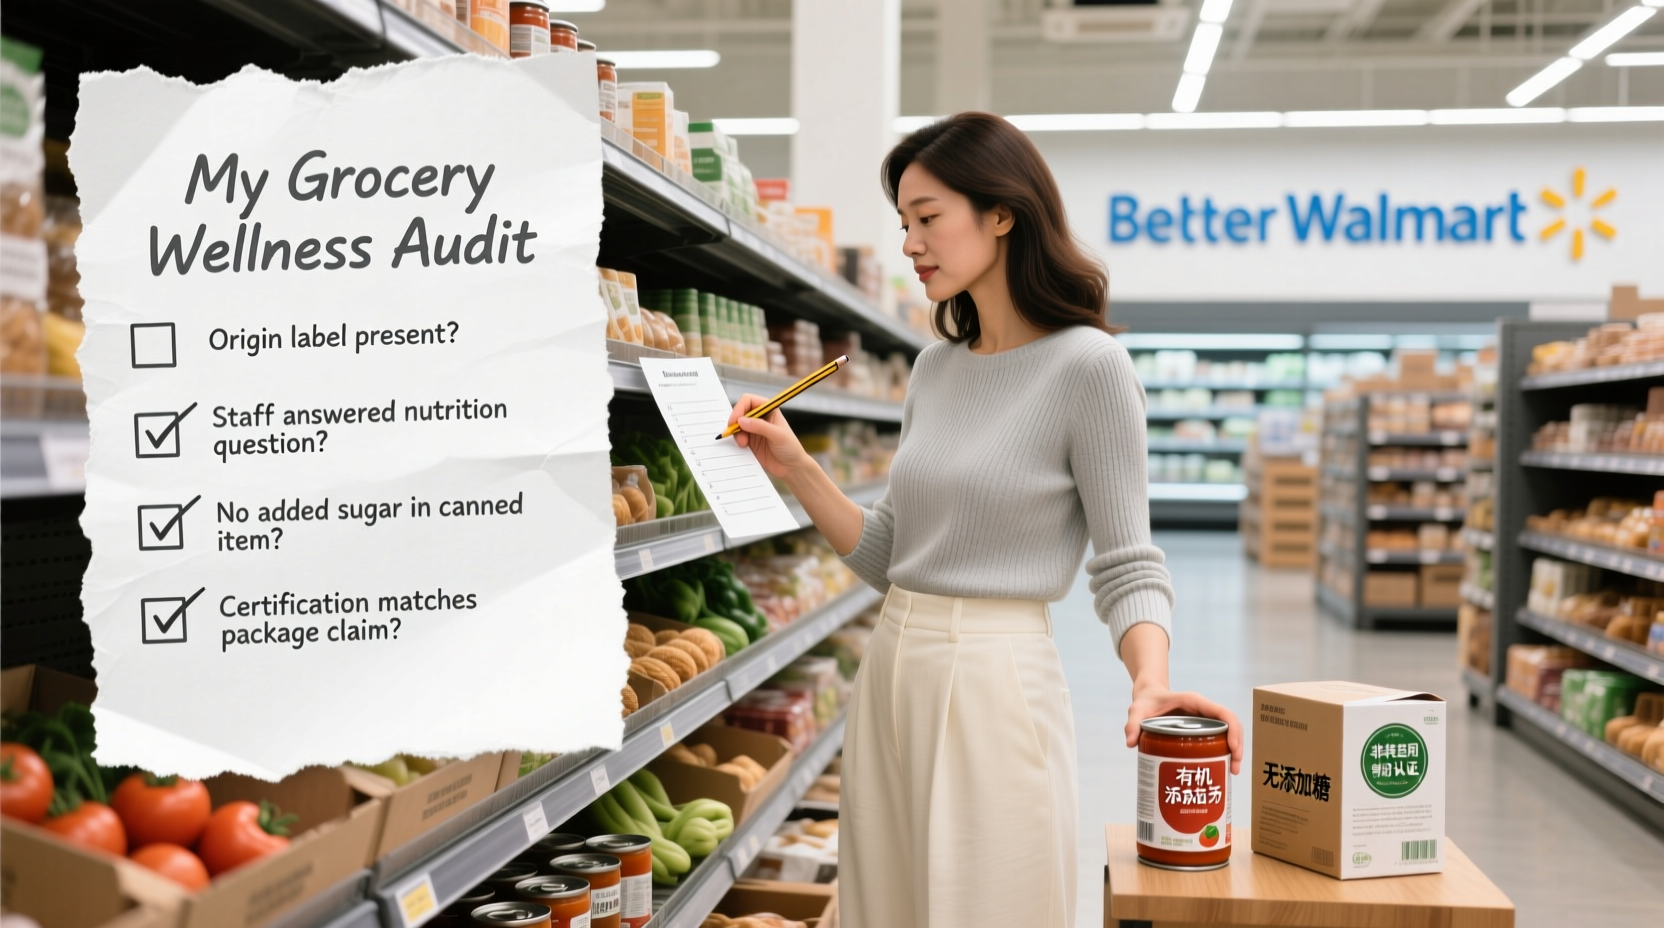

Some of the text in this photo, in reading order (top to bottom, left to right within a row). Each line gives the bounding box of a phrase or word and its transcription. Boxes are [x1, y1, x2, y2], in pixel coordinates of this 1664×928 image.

[185, 150, 495, 219] My Grocery
[1108, 191, 1527, 243] Better Walmart
[150, 214, 537, 276] Wellness Audit
[209, 321, 459, 357] Origin label present?
[213, 399, 507, 428] Staff answered nutrition
[214, 430, 328, 463] question?
[217, 491, 523, 526] No added sugar in canned
[218, 526, 284, 552] item?
[219, 588, 477, 618] Certification matches
[222, 617, 402, 652] package claim?
[1175, 766, 1213, 787] 有机
[1262, 761, 1331, 803] 无添加糖
